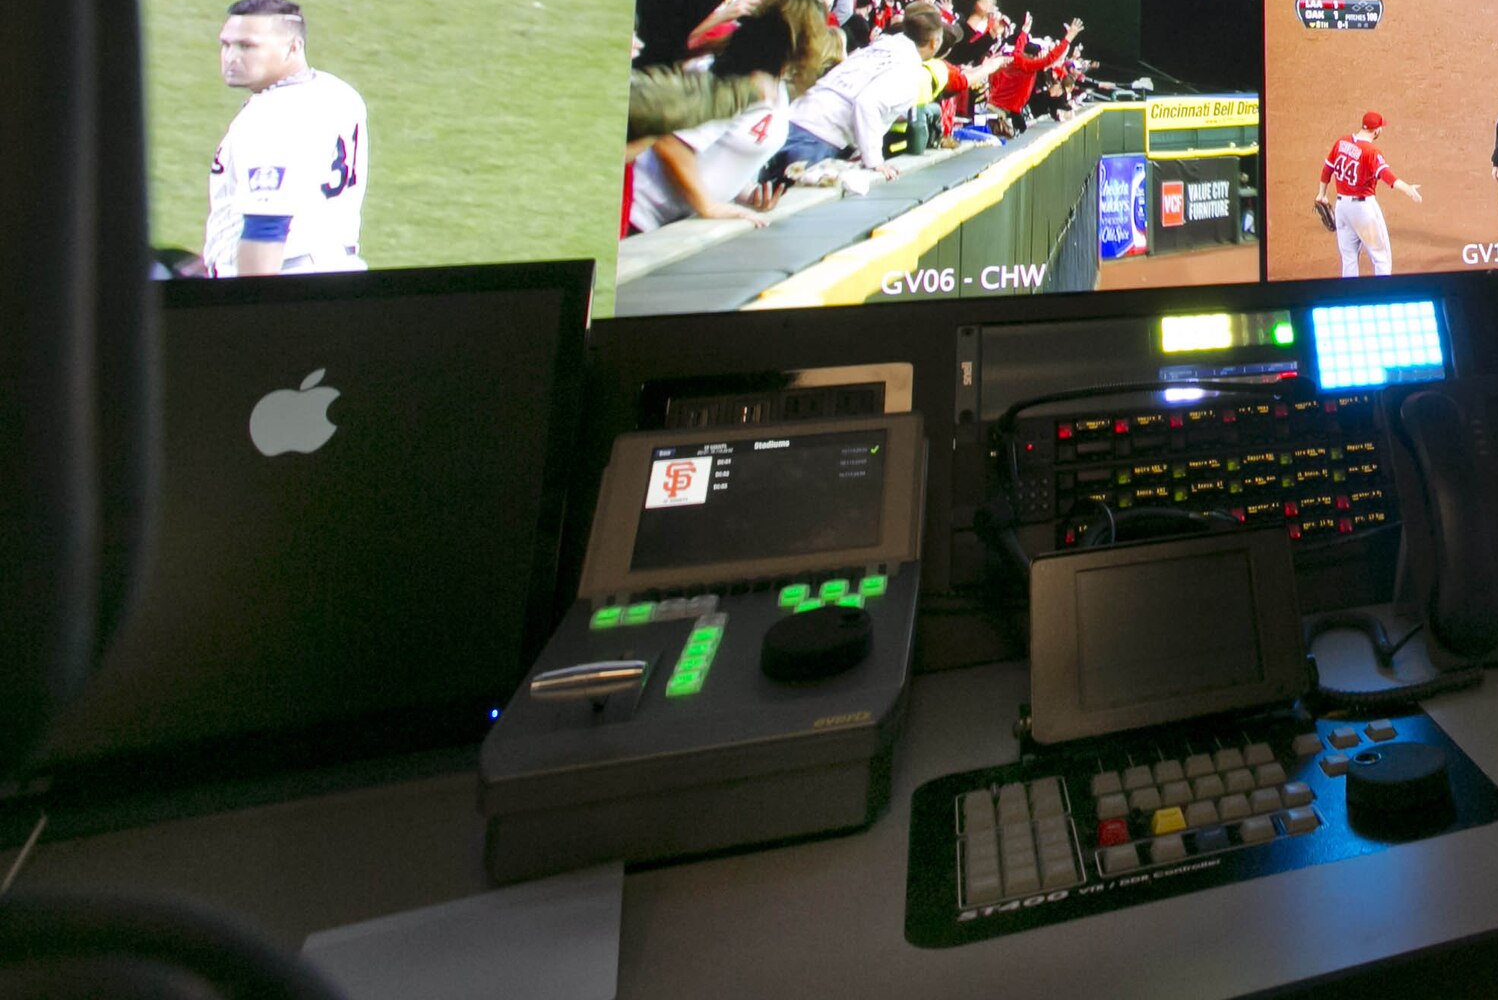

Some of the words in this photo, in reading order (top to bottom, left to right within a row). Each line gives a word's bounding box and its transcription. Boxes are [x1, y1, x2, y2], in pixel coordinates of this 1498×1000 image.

[1305, 0, 1323, 8] LAA
[1305, 10, 1325, 19] OAK
[1150, 103, 1210, 120] Cincinnati
[1213, 101, 1234, 117] Bell
[749, 114, 774, 146] 4
[320, 123, 359, 199] 31
[1333, 155, 1360, 186] 44
[1187, 182, 1211, 201] VALUE
[1212, 181, 1230, 199] CITY
[1163, 194, 1183, 214] VCF
[1188, 200, 1229, 220] FURNITURE
[881, 267, 954, 295] GV06
[981, 262, 1046, 289] CHW
